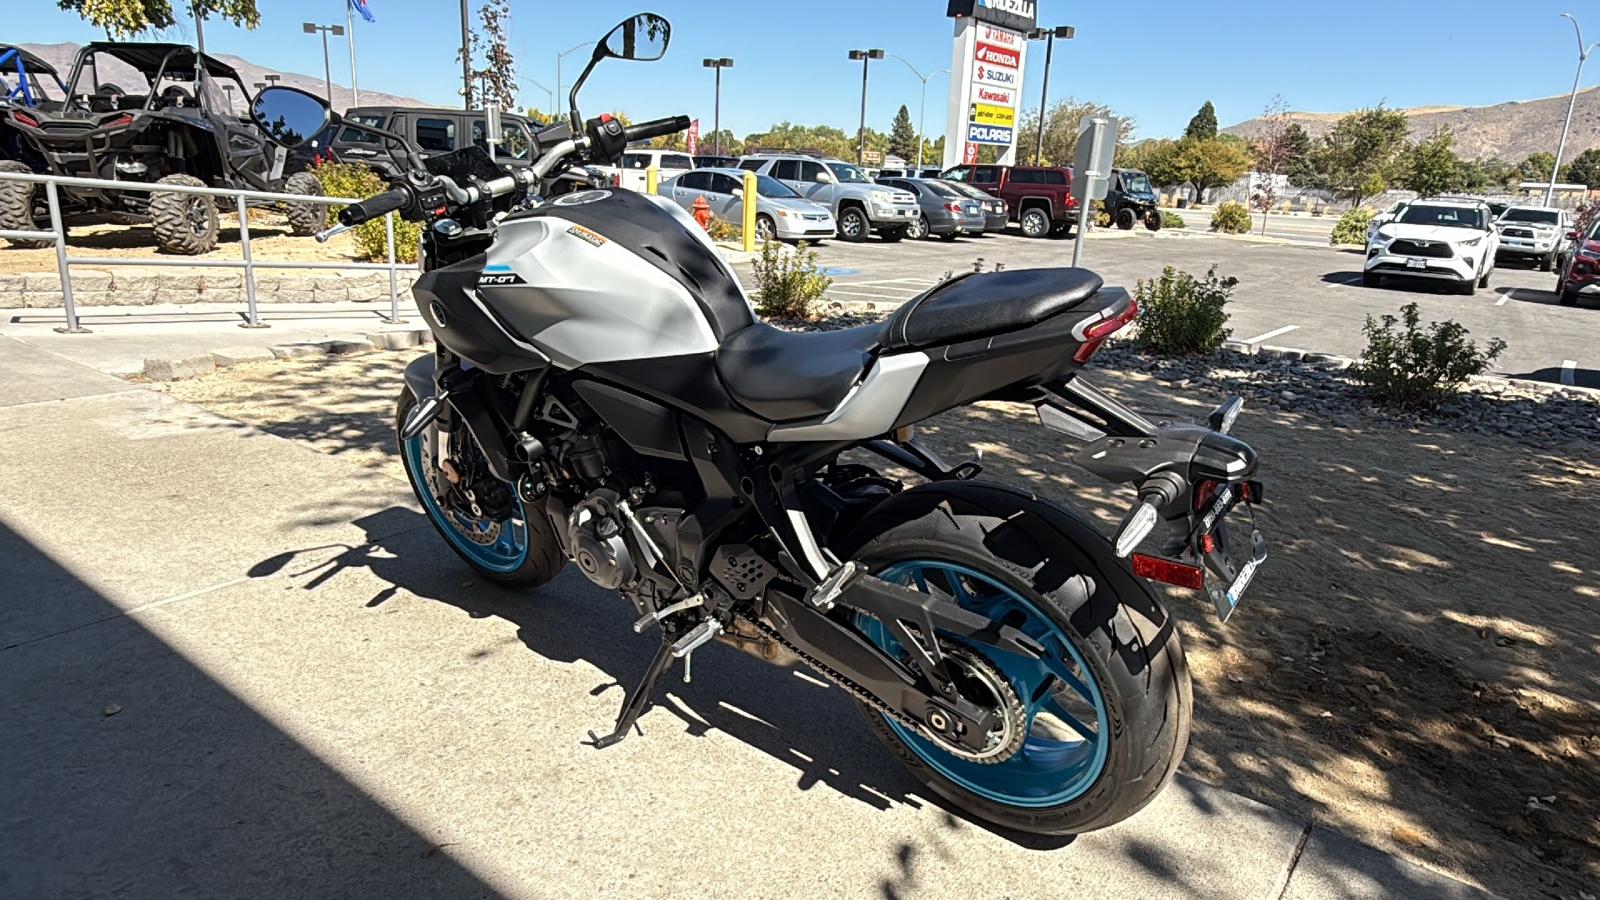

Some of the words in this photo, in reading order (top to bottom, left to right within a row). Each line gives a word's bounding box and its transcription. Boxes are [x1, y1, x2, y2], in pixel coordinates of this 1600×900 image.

[992, 27, 1014, 45] YAMAHA
[986, 50, 1017, 67] HONDA
[986, 70, 1014, 84] SUZUKI
[978, 88, 1010, 103] Kawasaki
[969, 126, 1011, 142] POLARIS
[478, 275, 516, 284] MT-07
